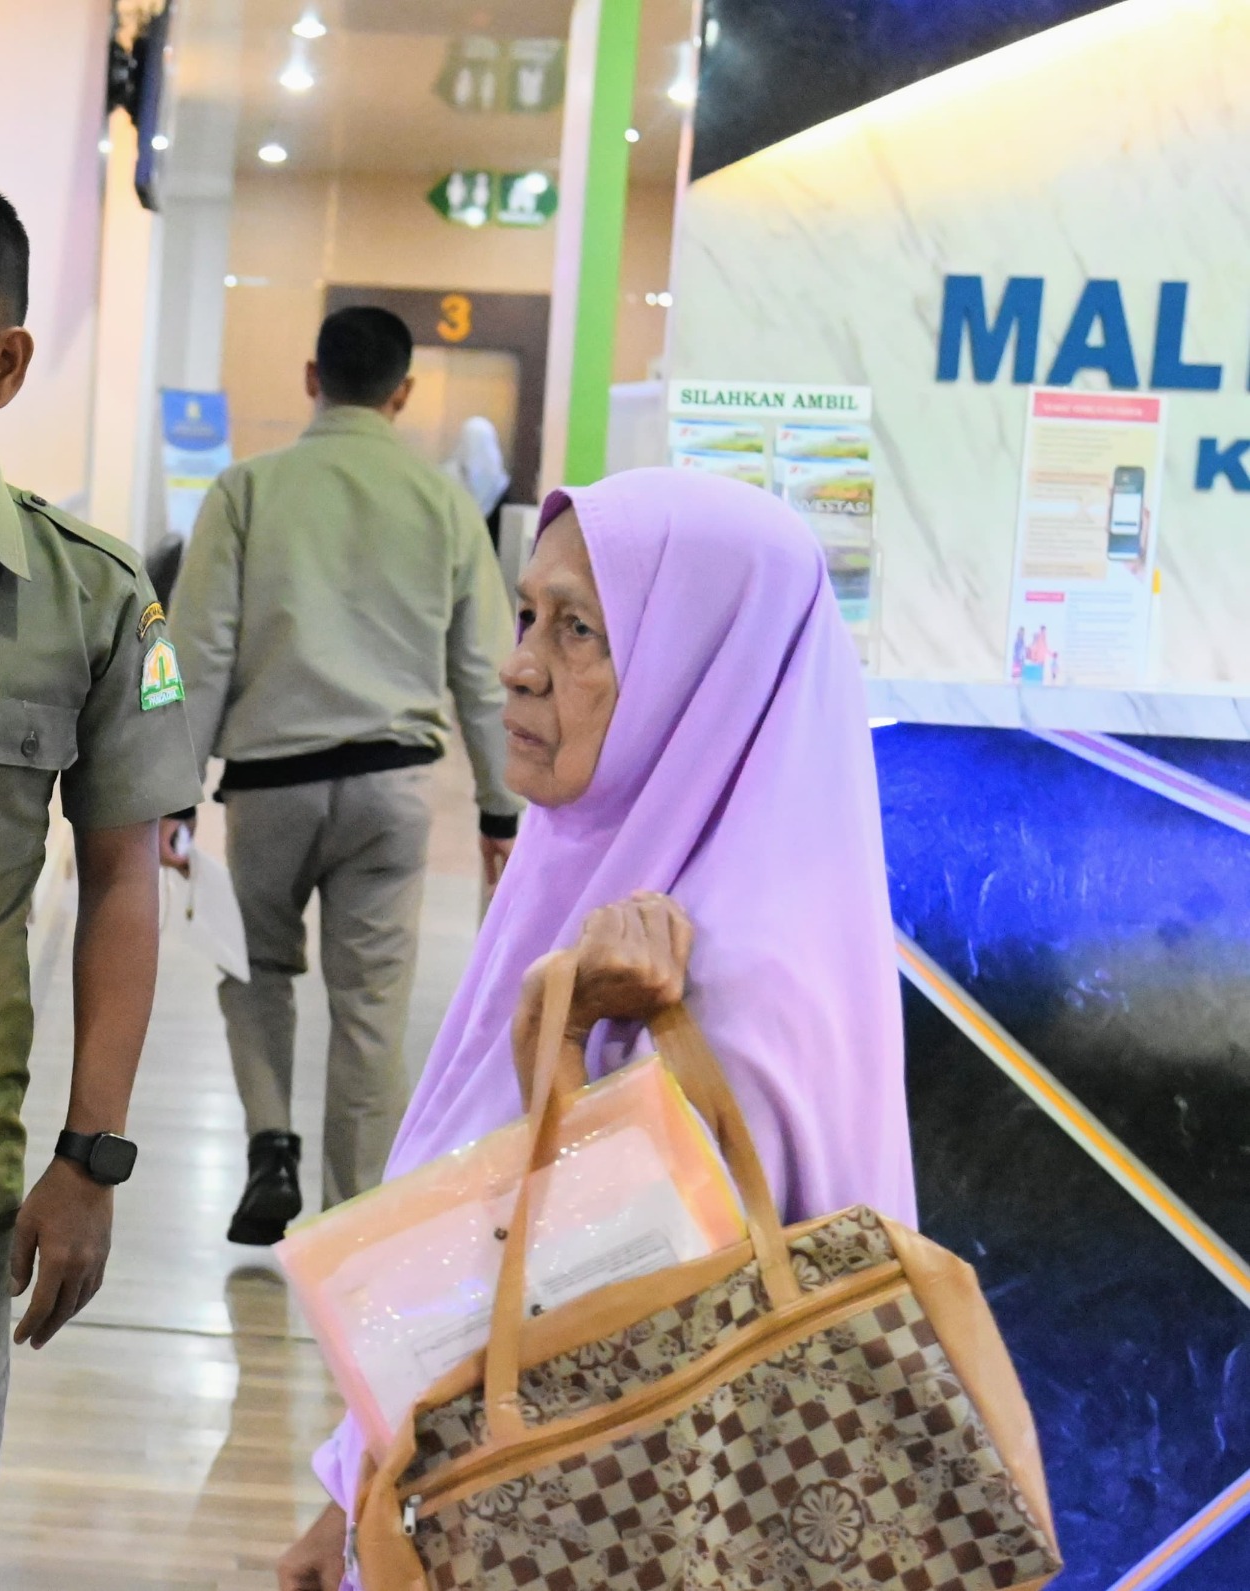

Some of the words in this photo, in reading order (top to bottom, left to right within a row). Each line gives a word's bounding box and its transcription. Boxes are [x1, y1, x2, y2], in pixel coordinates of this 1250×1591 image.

[436, 293, 472, 342] 3
[935, 274, 1223, 391] MAL
[681, 388, 785, 408] SILAHKAN
[792, 393, 859, 410] AMBIL
